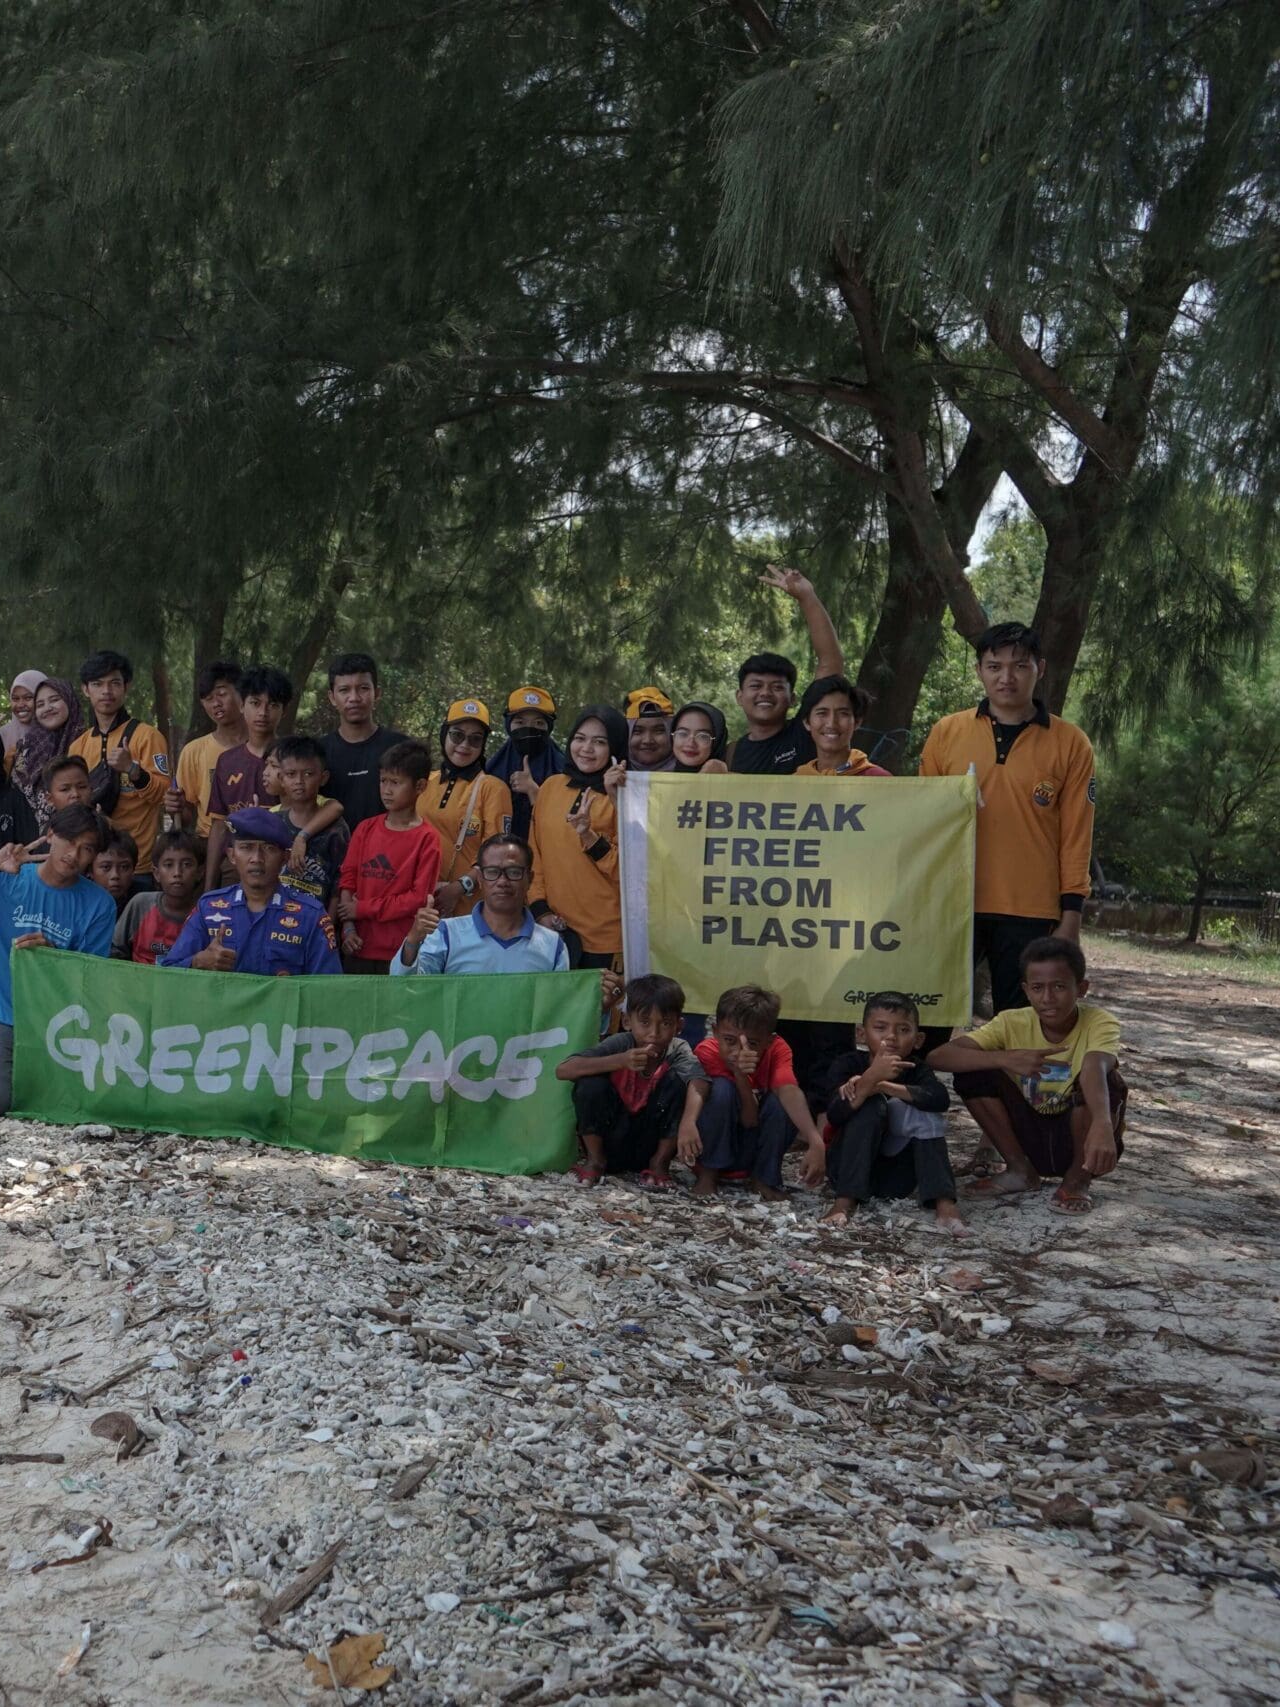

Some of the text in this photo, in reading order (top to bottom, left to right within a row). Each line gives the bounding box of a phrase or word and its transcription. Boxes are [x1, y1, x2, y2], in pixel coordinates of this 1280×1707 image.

[677, 799, 867, 832] #BREAK
[703, 837, 821, 868] FREE
[702, 875, 832, 909] FROM
[207, 927, 233, 937] ETO
[270, 931, 303, 945] POLRI
[702, 914, 902, 952] PLASTIC
[45, 1004, 569, 1104] GREENPEACE
